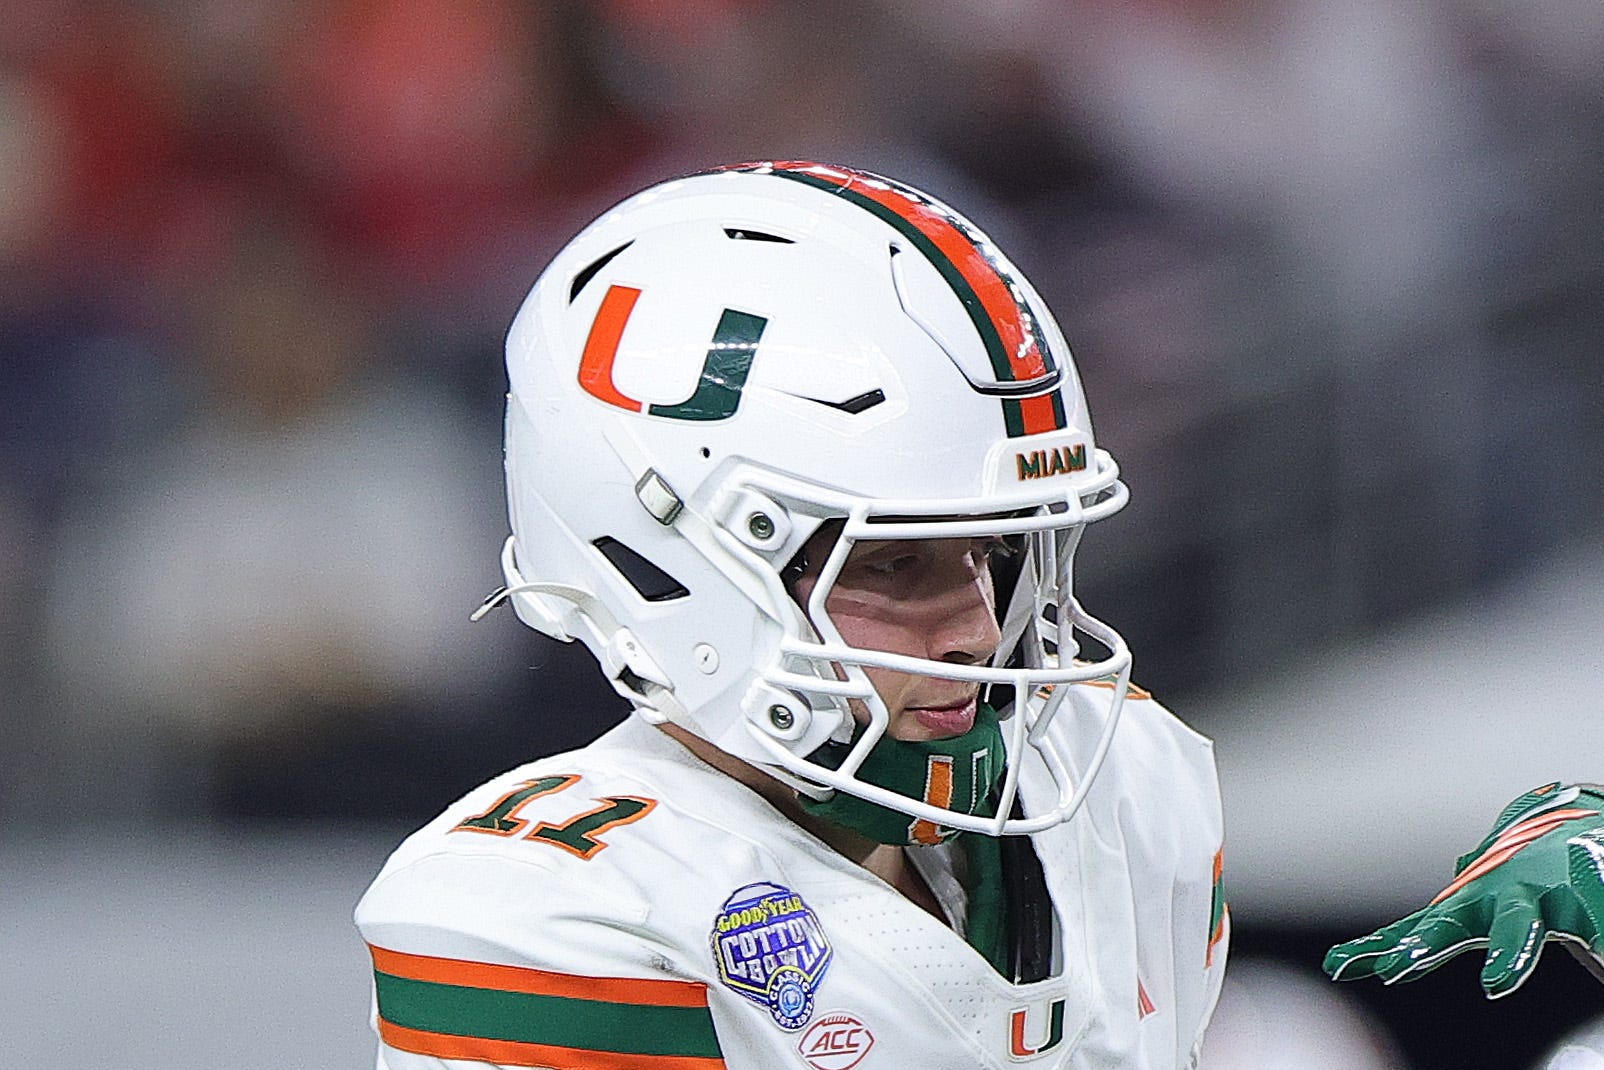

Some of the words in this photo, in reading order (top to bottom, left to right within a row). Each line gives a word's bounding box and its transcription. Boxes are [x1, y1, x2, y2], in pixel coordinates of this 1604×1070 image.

[577, 284, 770, 422] U
[1016, 443, 1087, 481] MIAMI
[446, 774, 659, 861] 11
[721, 914, 826, 977] COTTON
[747, 945, 815, 983] BOWL
[810, 1028, 864, 1052] ACC
[1011, 999, 1066, 1056] U
